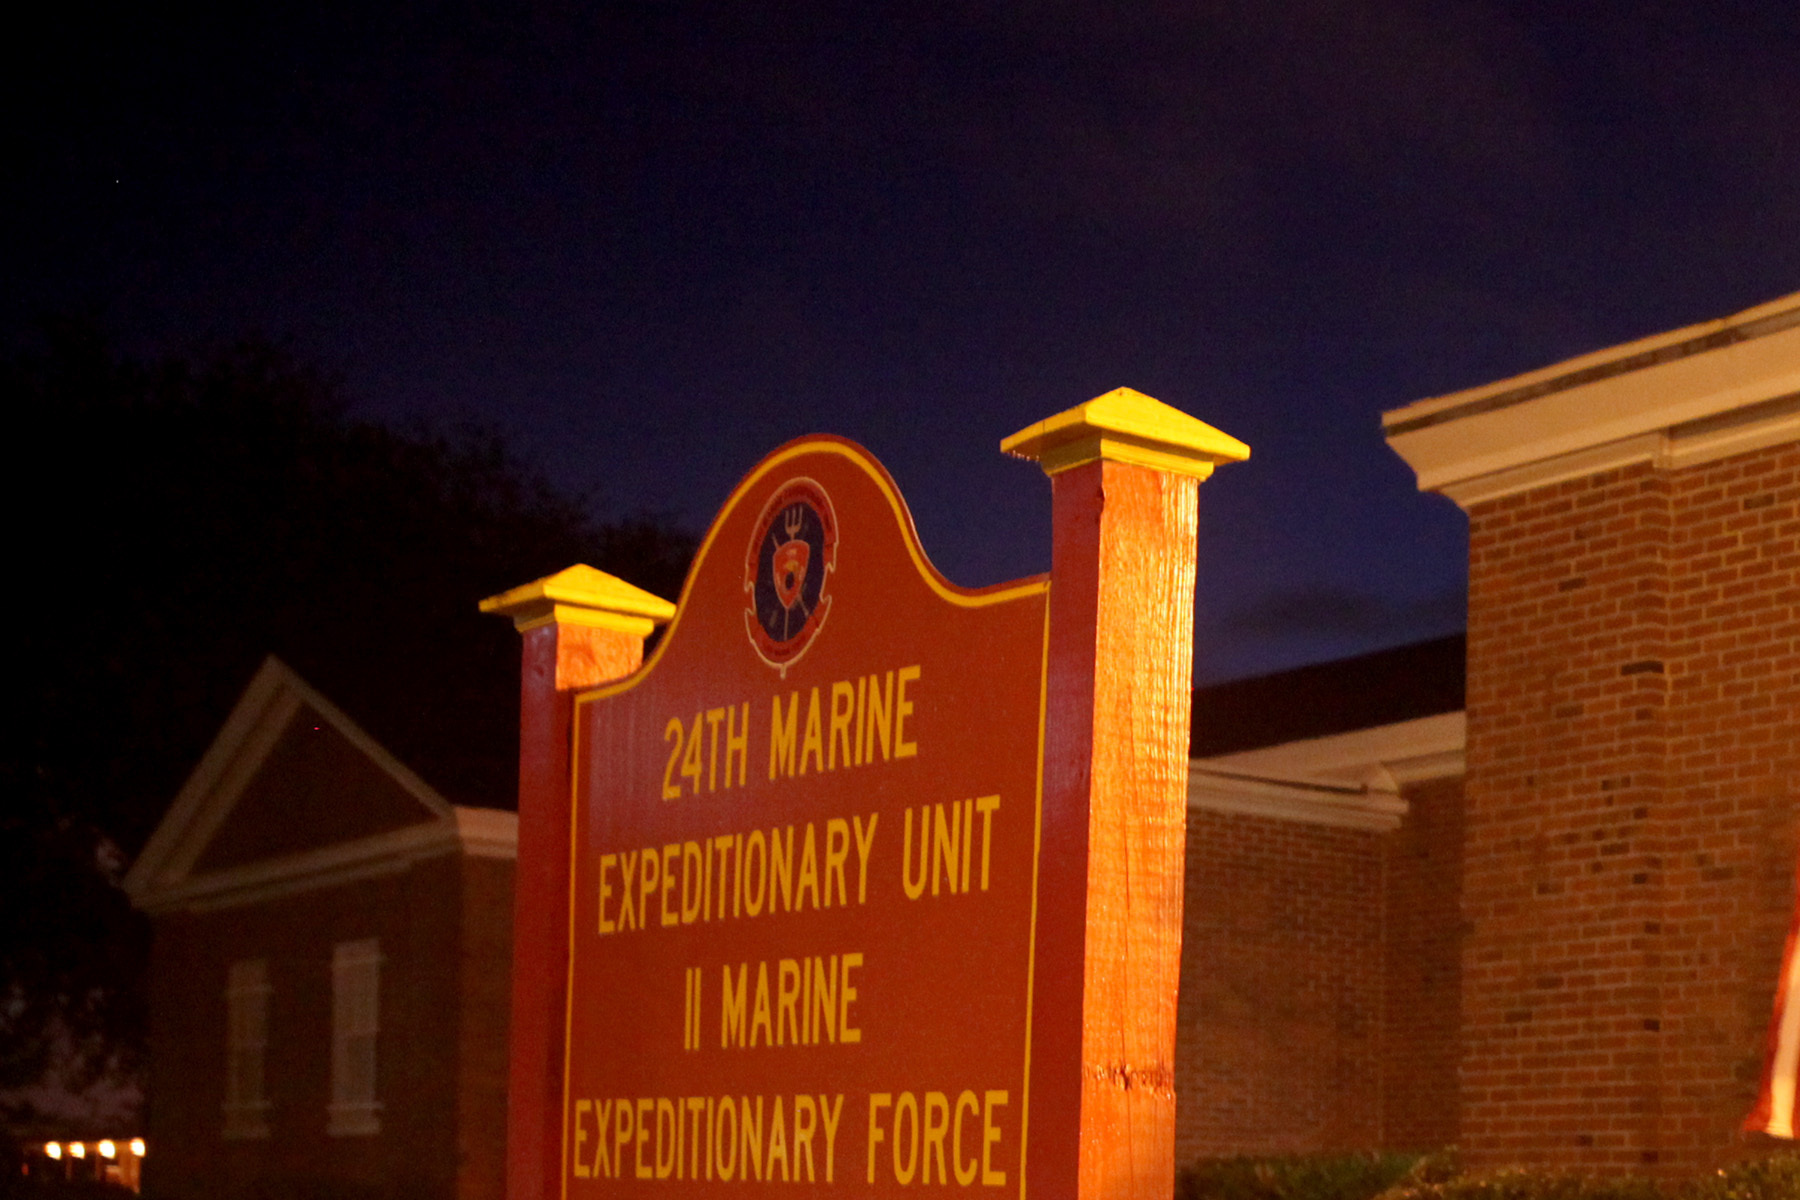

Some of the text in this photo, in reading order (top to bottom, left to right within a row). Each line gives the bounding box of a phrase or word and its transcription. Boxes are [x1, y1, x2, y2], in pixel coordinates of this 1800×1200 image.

[662, 665, 921, 801] 24TH MARINE
[599, 795, 1000, 933] EXPEDITIONARY UNIT
[684, 953, 863, 1051] II MARINE
[574, 1089, 1009, 1187] EXPEDITIONARY FORCE
